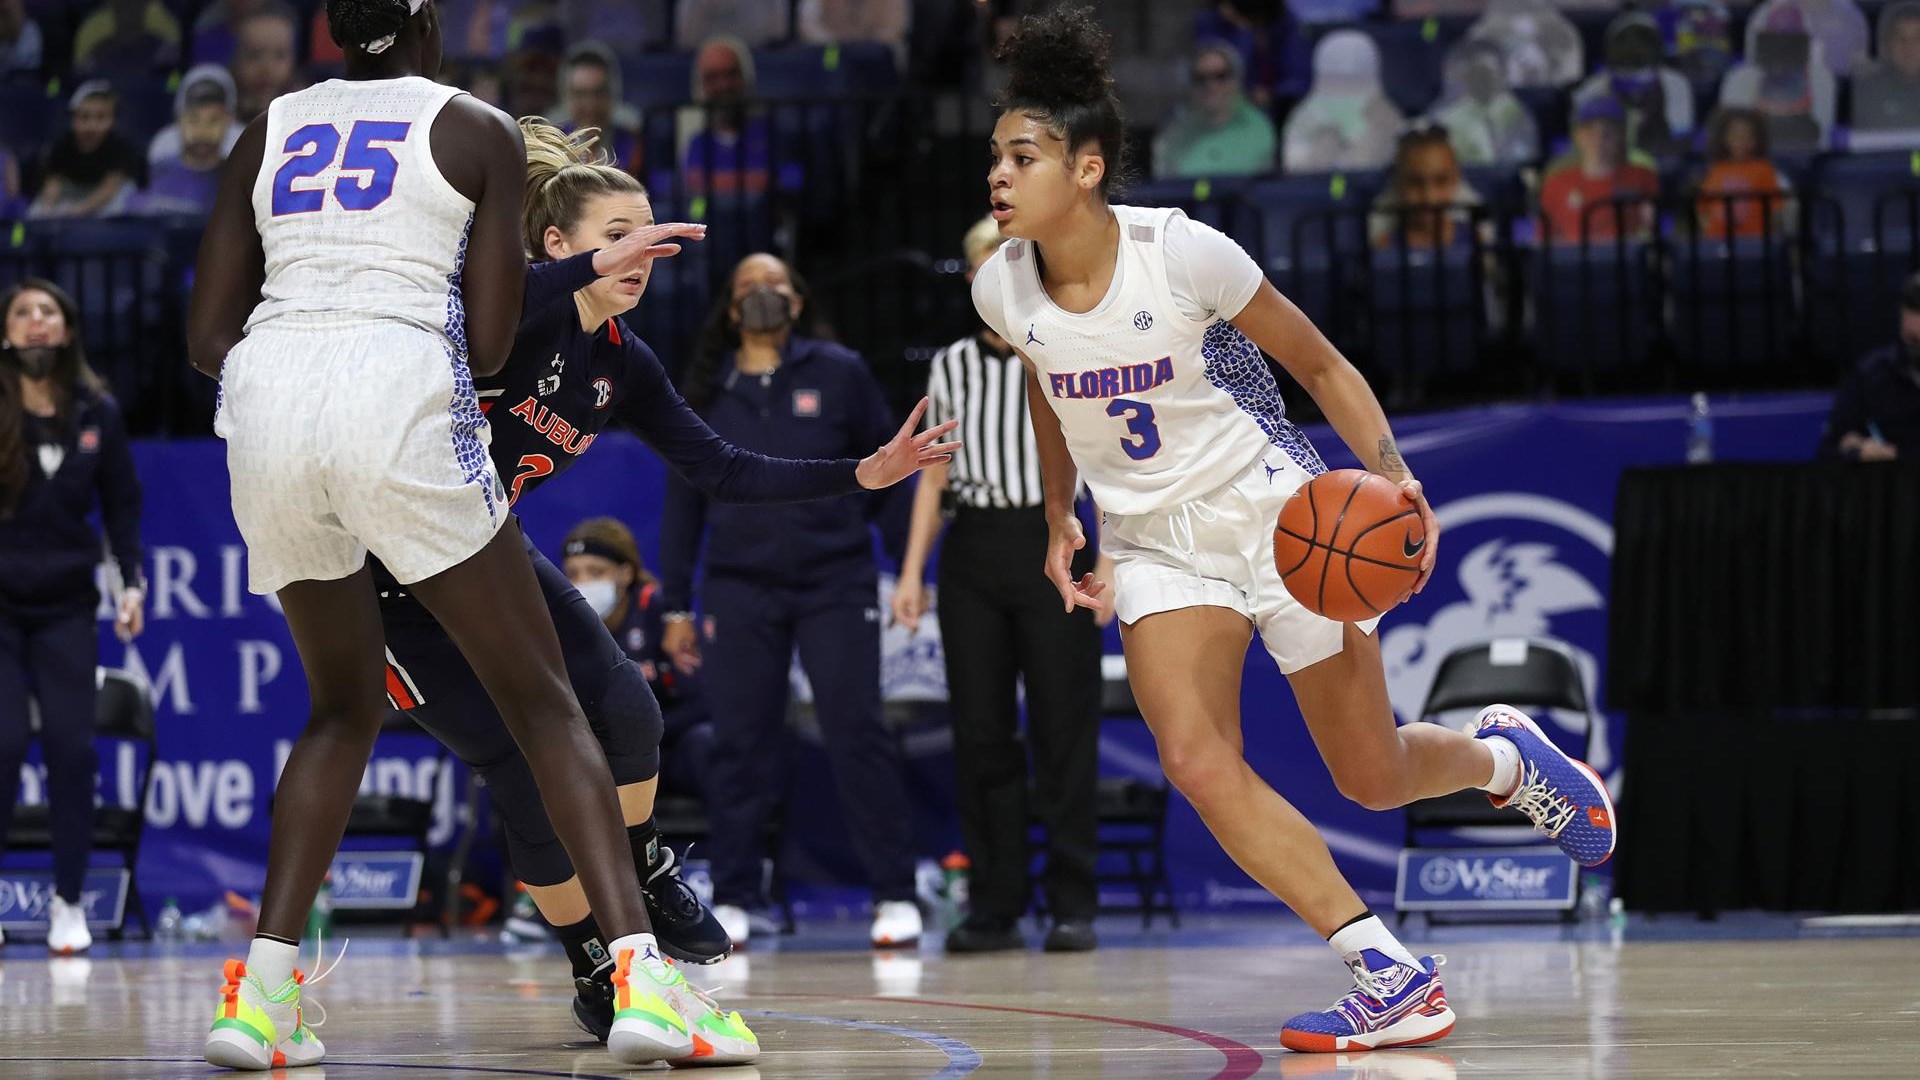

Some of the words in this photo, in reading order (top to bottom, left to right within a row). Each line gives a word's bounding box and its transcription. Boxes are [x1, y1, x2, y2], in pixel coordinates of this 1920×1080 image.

[272, 119, 412, 217] 25
[1134, 311, 1153, 330] SEC
[1047, 355, 1174, 399] FLORIDA
[1105, 398, 1161, 460] 3
[1456, 857, 1556, 894] VyStar
